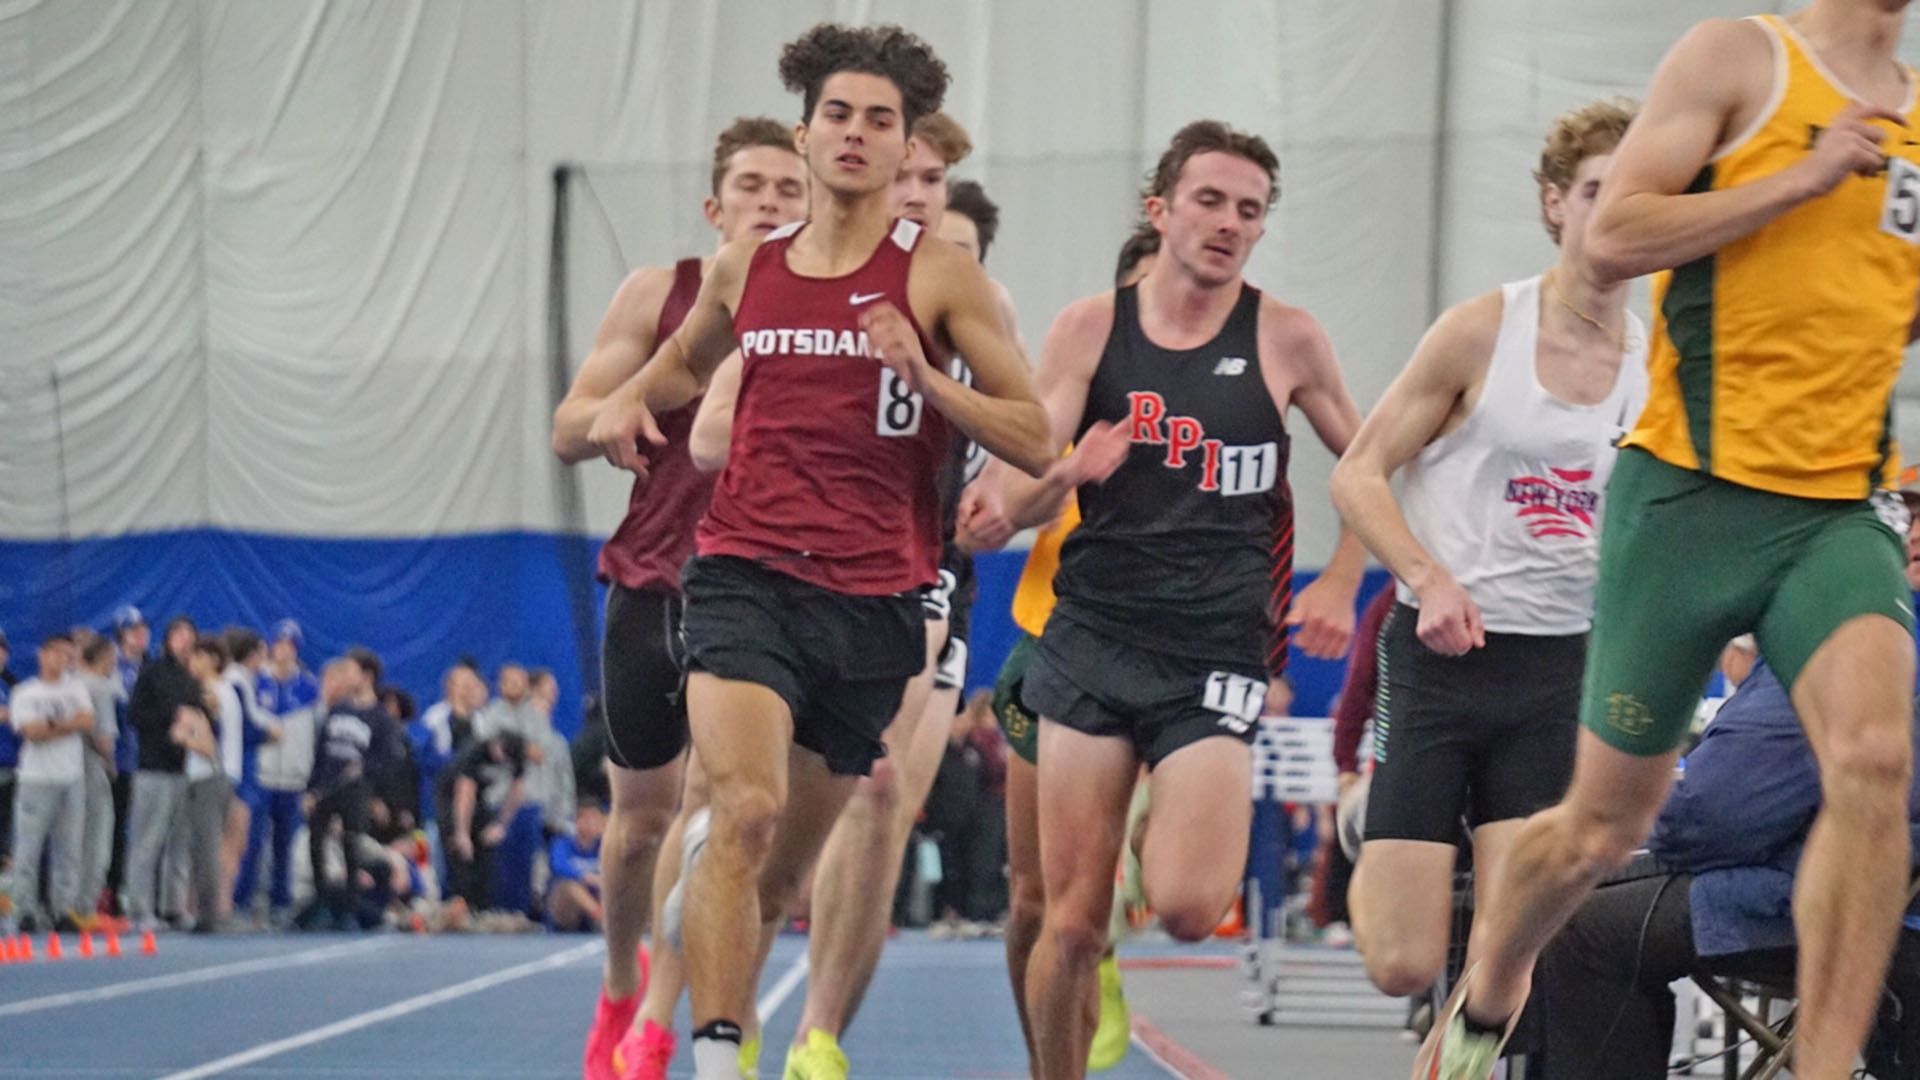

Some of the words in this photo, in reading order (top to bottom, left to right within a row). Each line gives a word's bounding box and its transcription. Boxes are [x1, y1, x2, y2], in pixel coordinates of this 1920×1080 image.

[885, 373, 915, 431] 8
[1126, 390, 1224, 491] RPI
[1227, 449, 1264, 491] 11
